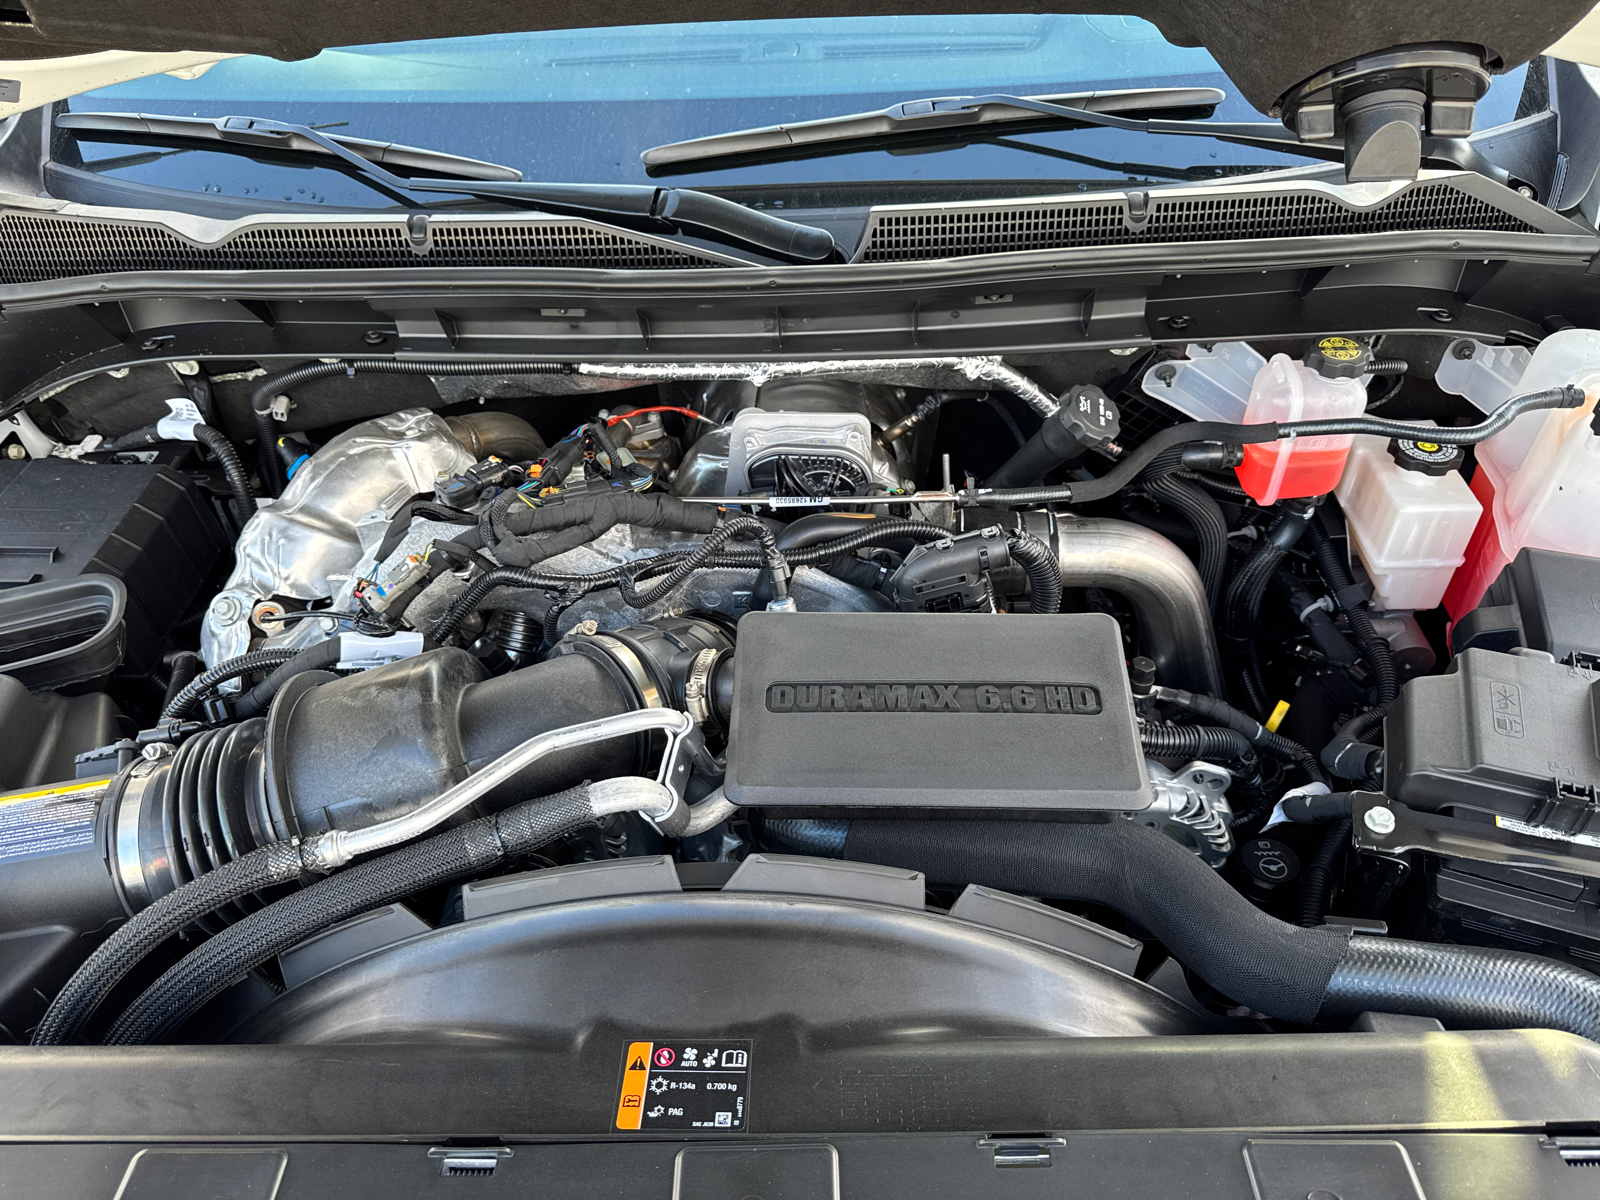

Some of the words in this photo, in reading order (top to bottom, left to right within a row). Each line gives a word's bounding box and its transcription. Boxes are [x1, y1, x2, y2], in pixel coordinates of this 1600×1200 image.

[769, 684, 961, 710] DURAMAX
[975, 684, 1036, 710] 6.6
[1045, 685, 1099, 712] HD
[670, 1082, 696, 1090] R-134a
[706, 1082, 727, 1090] 0.700
[727, 1082, 738, 1092] kg
[668, 1107, 684, 1116] PAG
